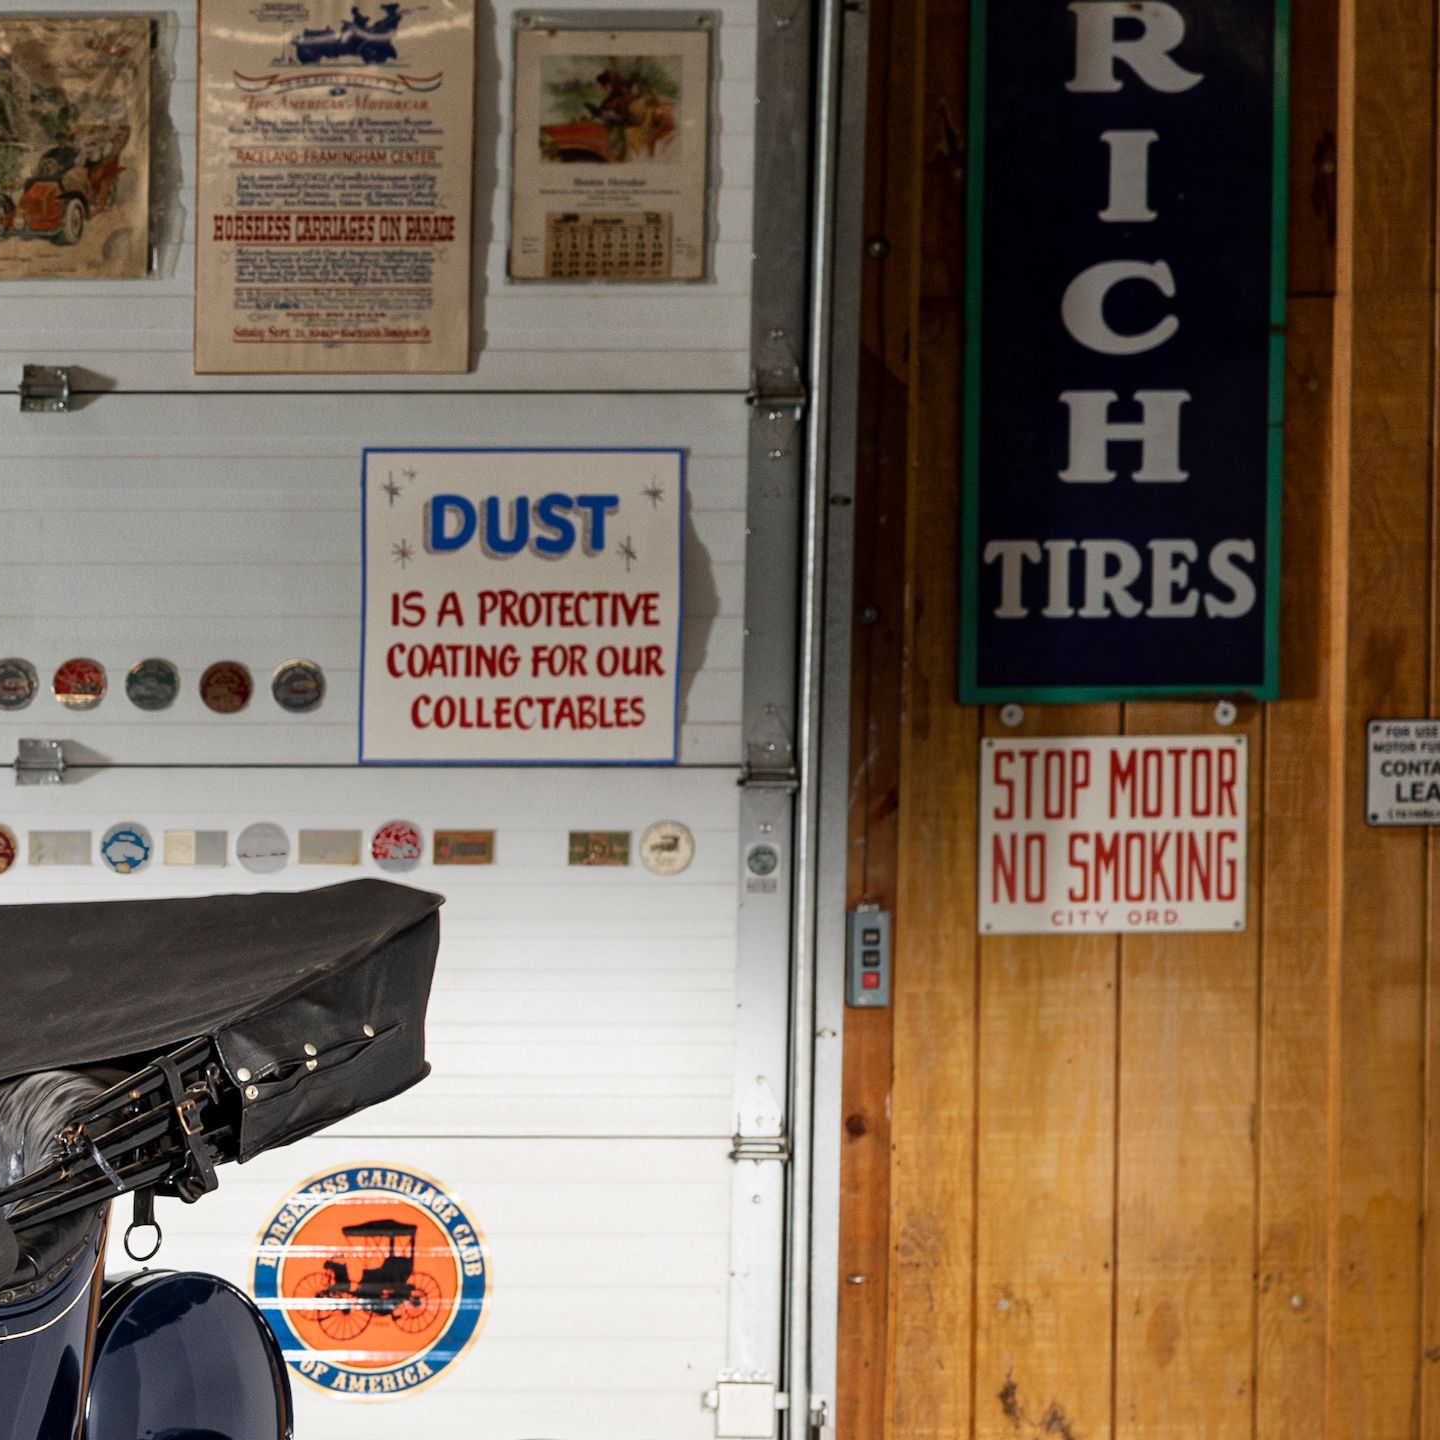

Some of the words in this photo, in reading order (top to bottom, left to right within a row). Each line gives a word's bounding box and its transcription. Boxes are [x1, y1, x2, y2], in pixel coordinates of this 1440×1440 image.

[391, 149, 437, 163] CENTER
[213, 214, 292, 242] HORSELESS
[295, 214, 375, 242] CARRIAGES
[379, 214, 402, 241] ON
[404, 214, 456, 242] PARADE
[1058, 1, 1205, 484] RICH
[428, 492, 620, 557] DUST
[983, 537, 1257, 619] TIRES
[391, 590, 427, 628] IS
[436, 590, 465, 627] A
[477, 589, 661, 628] PROTECTIVE
[385, 642, 521, 679] COATING
[531, 643, 589, 678] FOR
[595, 644, 665, 678] OUR
[410, 694, 647, 730] COLLECTABLES
[992, 748, 1091, 821] STOP
[1109, 746, 1238, 820] MOTOR
[991, 833, 1047, 904] NO
[1067, 830, 1238, 904] SMOKING
[1051, 909, 1109, 927] CITY
[356, 1169, 460, 1223] CARRIAGE
[452, 1224, 483, 1277] CLUB
[298, 1359, 329, 1380] OF
[331, 1359, 435, 1394] AMERICA
